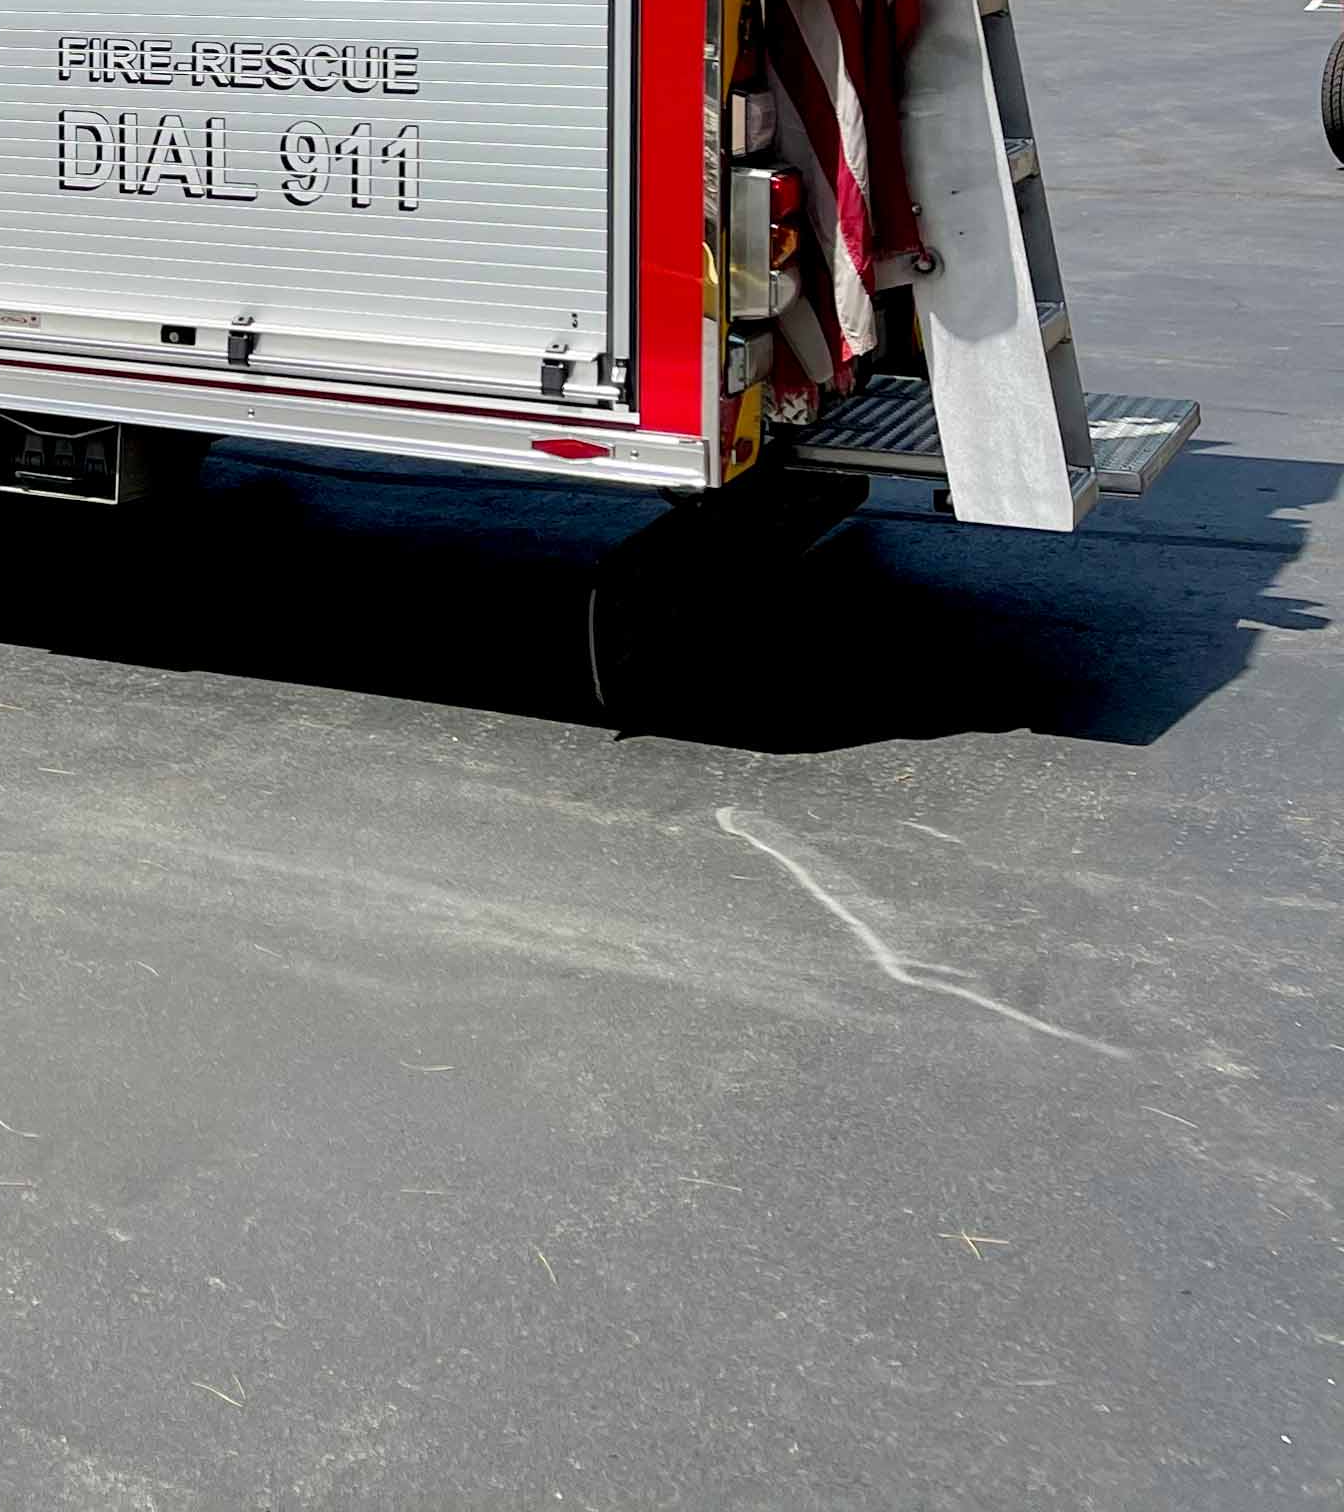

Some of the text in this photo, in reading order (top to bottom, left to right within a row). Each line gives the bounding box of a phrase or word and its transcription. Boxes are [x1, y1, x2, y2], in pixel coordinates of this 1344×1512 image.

[58, 37, 421, 94] FIRE-RESCUE
[58, 109, 421, 211] DIAL 911
